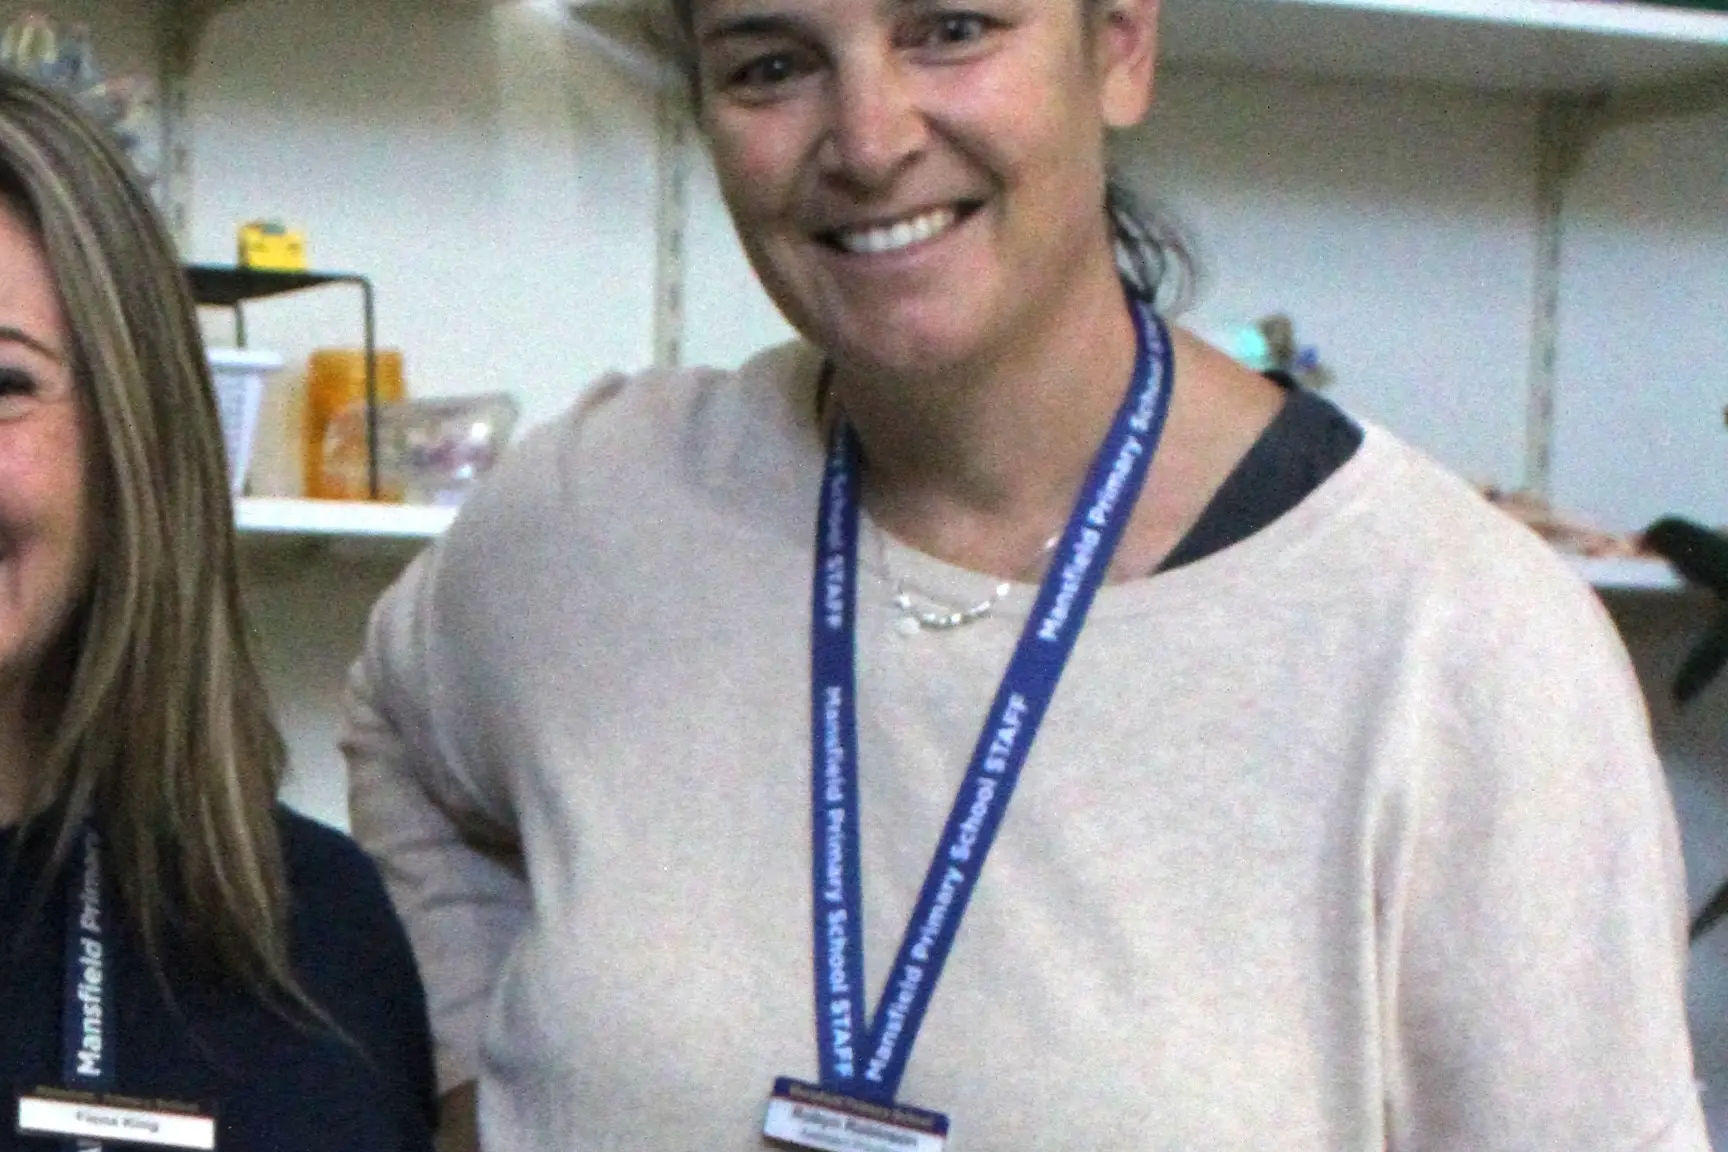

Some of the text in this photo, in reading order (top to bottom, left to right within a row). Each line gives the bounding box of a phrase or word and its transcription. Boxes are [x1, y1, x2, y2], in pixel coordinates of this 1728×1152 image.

[1037, 527, 1102, 641] Mansfield
[1088, 434, 1143, 526] Primary
[76, 937, 104, 1077] Mansfield
[824, 686, 854, 1080] Mansfield Primary School STAFF
[864, 692, 1029, 1082] Mansfield Primary School STAFF
